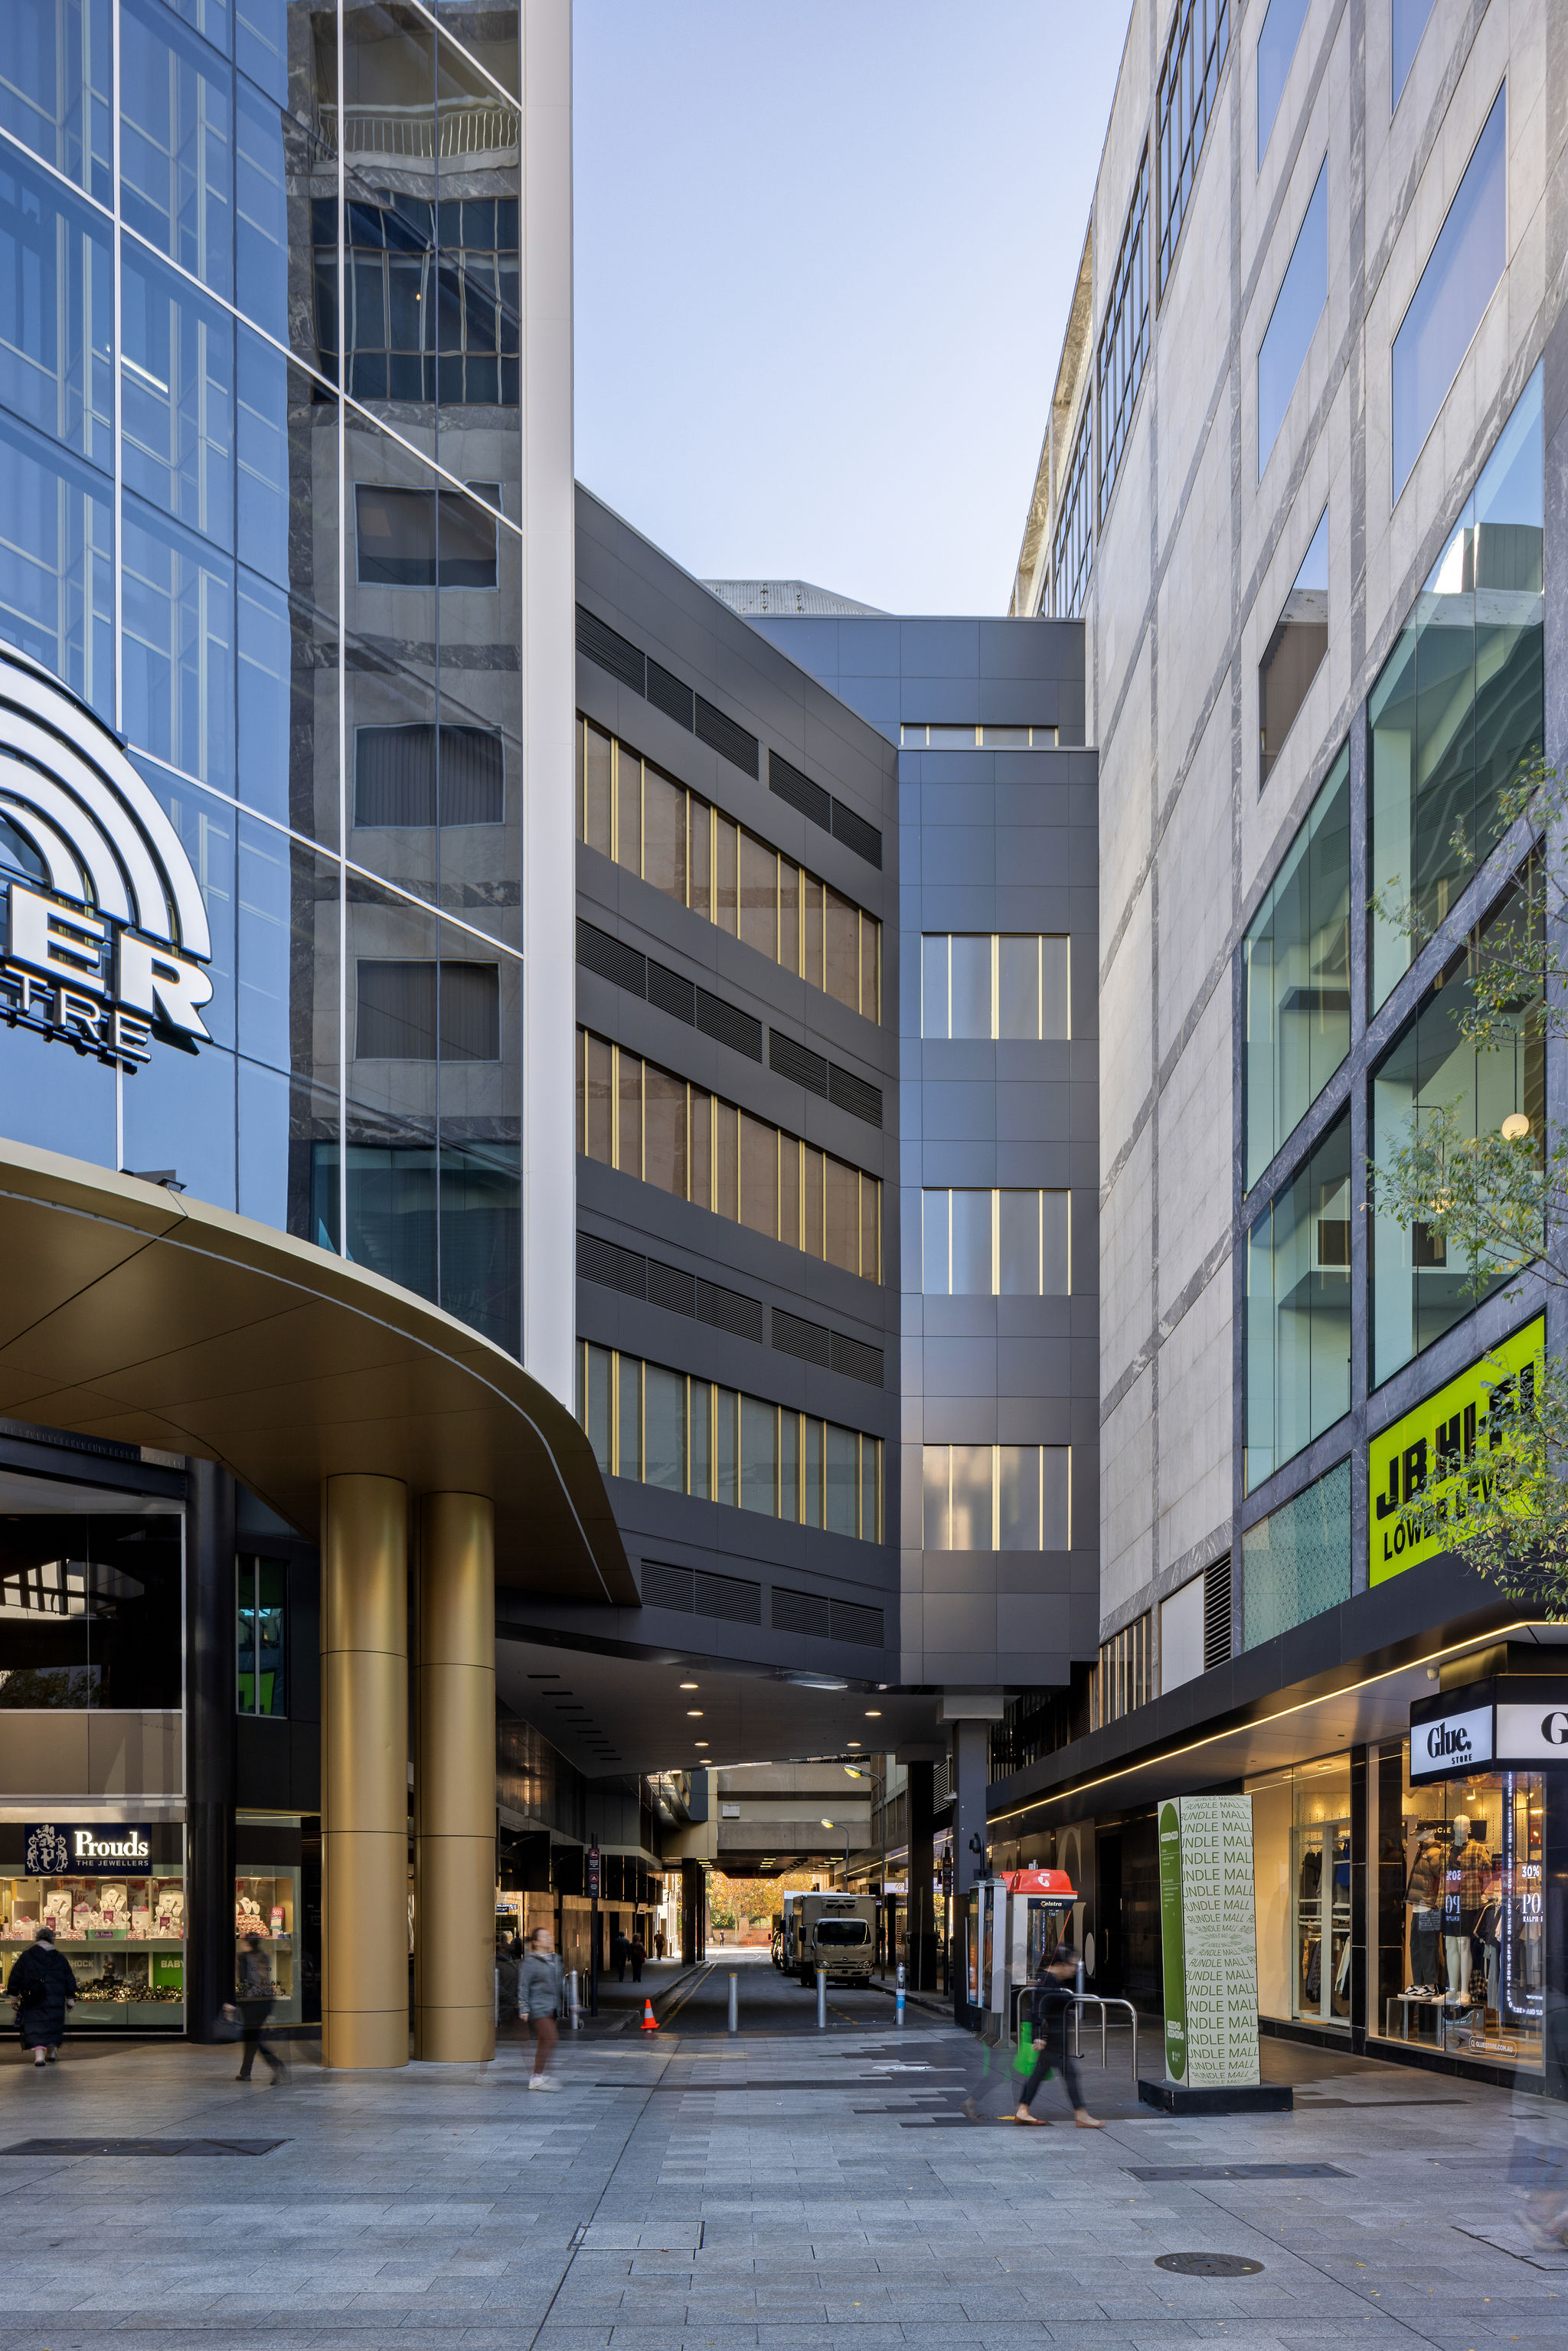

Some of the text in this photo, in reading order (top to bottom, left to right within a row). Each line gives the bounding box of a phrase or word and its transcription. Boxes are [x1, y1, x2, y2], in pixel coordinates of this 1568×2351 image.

[1377, 1437, 1427, 1521] JB
[1452, 1754, 1472, 1764] STORE
[1184, 1802, 1217, 1810] RUNDLE
[1221, 1810, 1250, 1819] MALL
[1223, 1822, 1253, 1832] MALL
[74, 1831, 149, 1856] Prouds
[1522, 1865, 1540, 1878] 30%
[1225, 1885, 1254, 1896] MALL
[1223, 1900, 1250, 1910] MALL
[1187, 1914, 1220, 1924] RUNDLE
[1223, 1913, 1244, 1922] MALL
[1188, 1958, 1222, 1967] RUNDLE
[1224, 1957, 1248, 1967] MALL
[1226, 1969, 1254, 1980] MALL
[1227, 1983, 1257, 1996] MALL
[1187, 2017, 1224, 2029] NDLE
[1229, 2046, 1259, 2058] MALL
[1228, 2059, 1254, 2069] MALL
